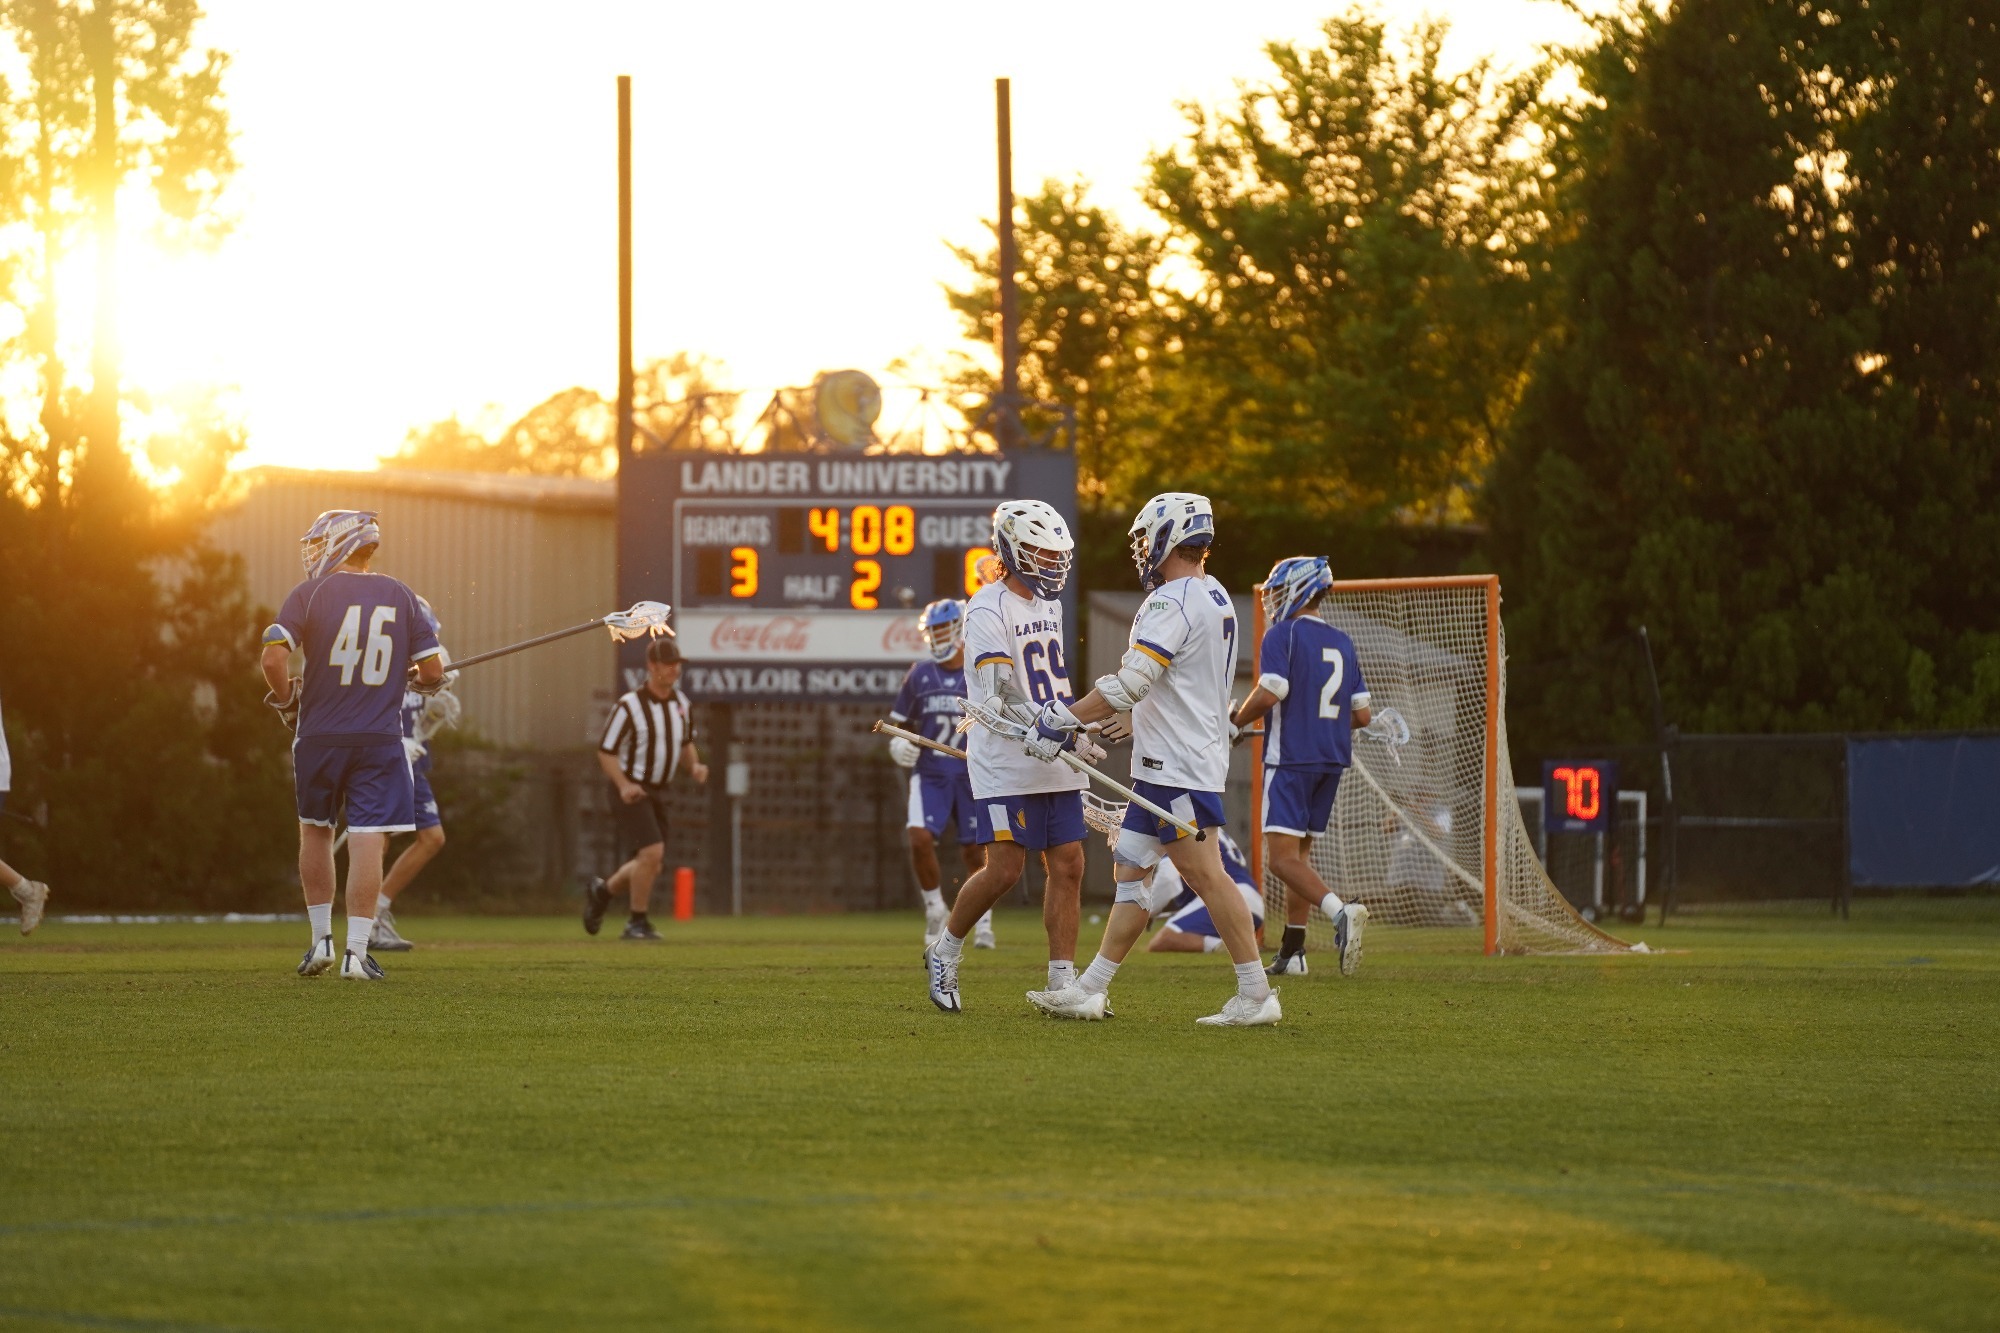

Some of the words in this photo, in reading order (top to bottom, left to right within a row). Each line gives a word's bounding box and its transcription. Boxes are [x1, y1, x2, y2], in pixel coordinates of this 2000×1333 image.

[681, 461, 810, 493] LANDER
[818, 461, 1012, 494] UNIVERSITY
[683, 515, 771, 545] BEARCATS
[920, 516, 994, 546] GUES
[730, 547, 759, 598] 3
[783, 575, 841, 600] HALF
[850, 559, 881, 611] 2
[1149, 601, 1169, 611] PBC
[328, 605, 397, 686] 46
[710, 614, 812, 653] Coca-Cola
[1223, 615, 1236, 690] 7
[687, 667, 802, 694] TAYLOR
[807, 667, 905, 694] SOCCE
[1023, 638, 1076, 709] 69
[1319, 647, 1344, 719] 2
[1553, 767, 1599, 820] 70
